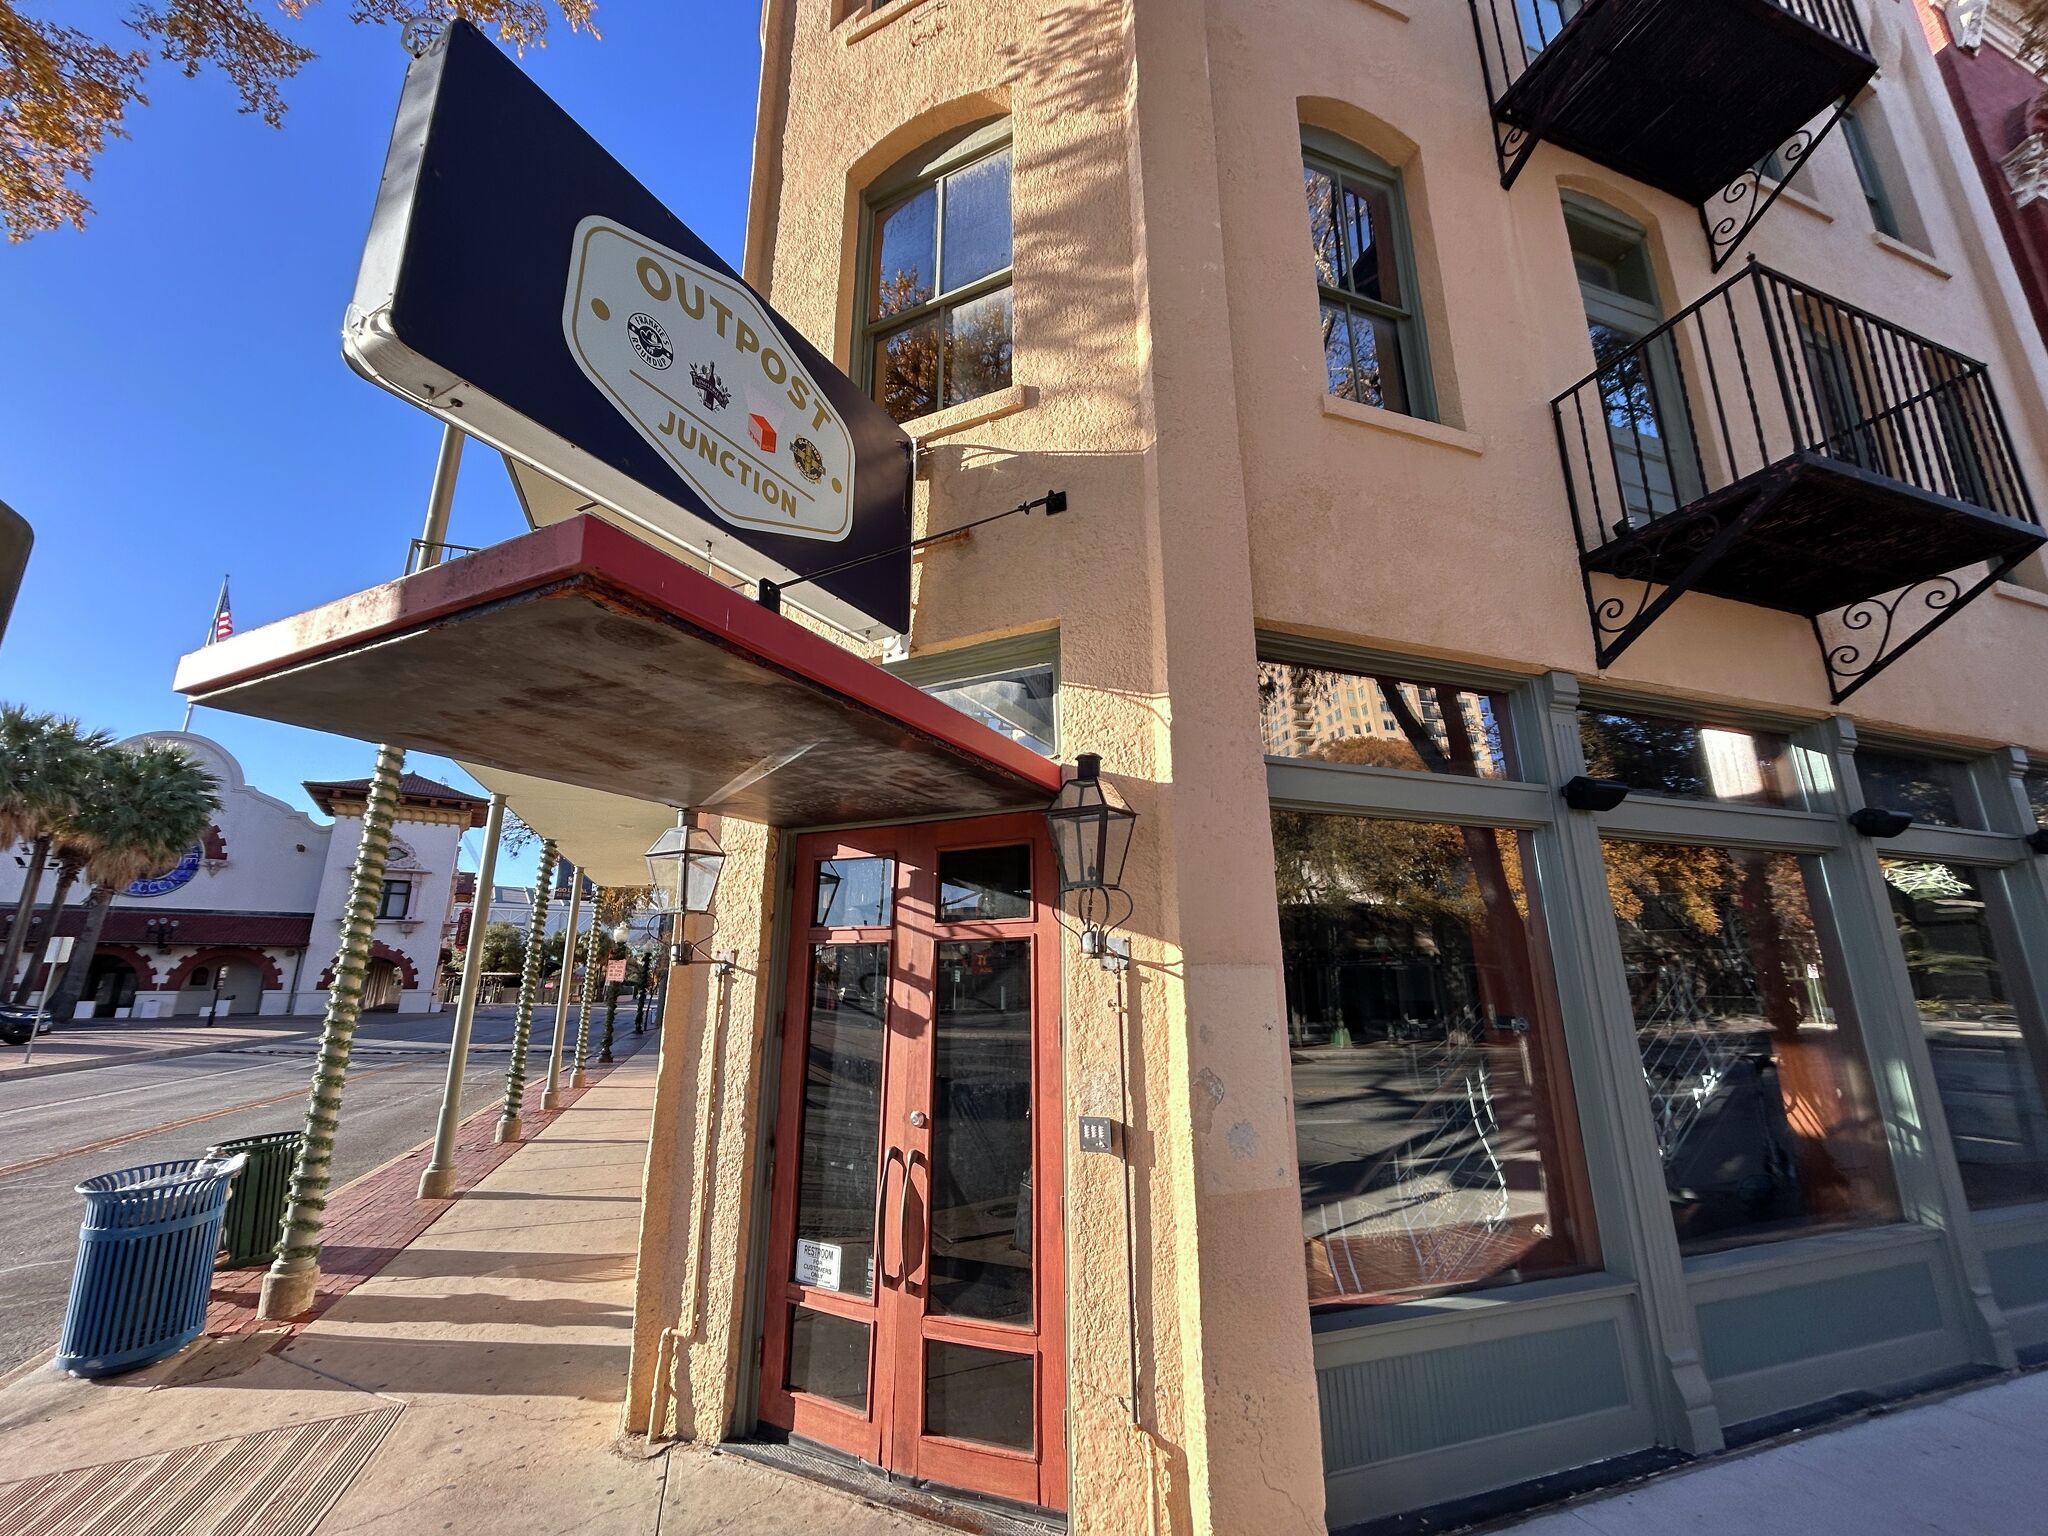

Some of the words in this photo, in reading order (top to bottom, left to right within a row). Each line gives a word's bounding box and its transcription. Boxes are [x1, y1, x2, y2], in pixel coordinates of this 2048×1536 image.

[635, 315, 669, 346] FRANKIE'S
[636, 256, 831, 431] OUTPOST
[631, 337, 667, 367] ROUNDUP
[657, 411, 797, 518] JUNCTION
[804, 1245, 833, 1260] RESTROOM
[803, 1264, 832, 1275] CUSTOMERS
[811, 1271, 823, 1279] ONLY
